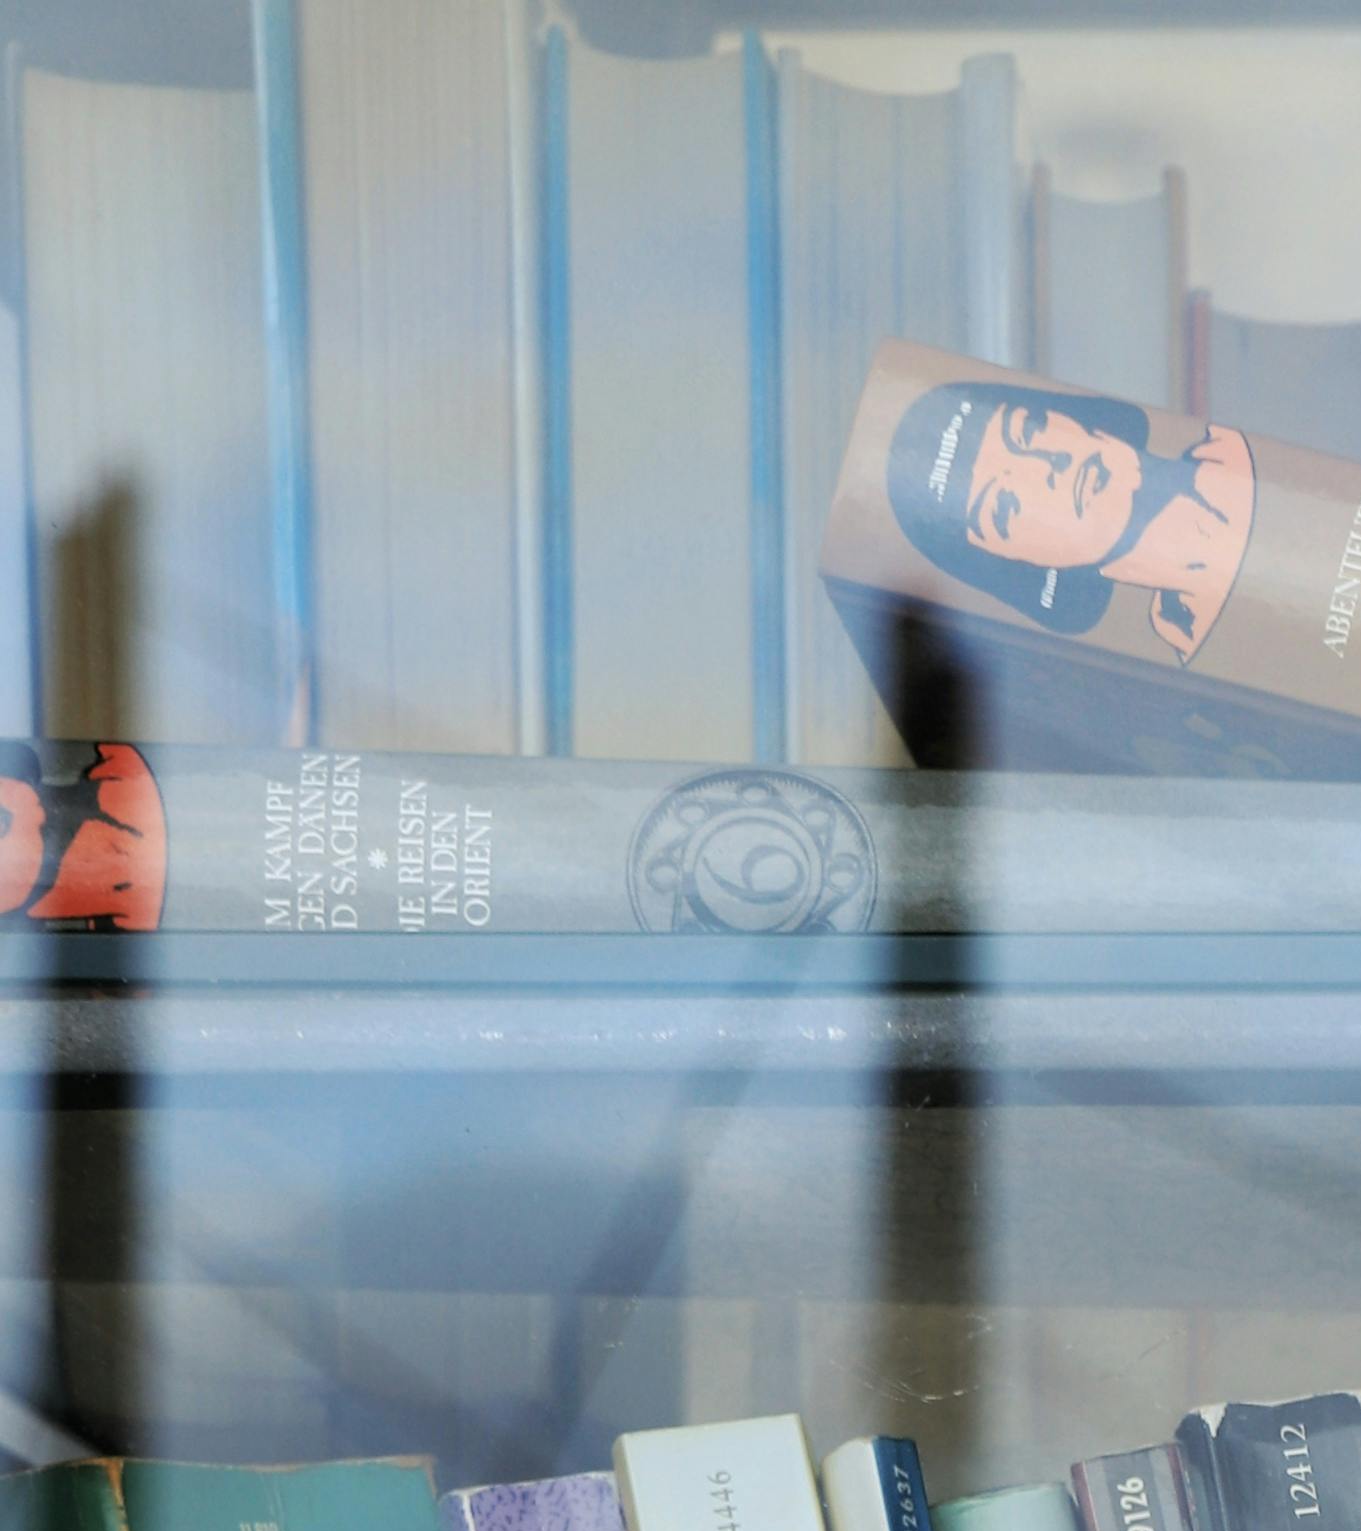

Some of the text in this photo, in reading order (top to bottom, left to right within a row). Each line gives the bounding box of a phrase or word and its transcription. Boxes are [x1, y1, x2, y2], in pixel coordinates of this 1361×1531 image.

[266, 780, 295, 892] KAMPF
[300, 752, 328, 855] DÄNEN
[332, 754, 360, 897] SACHSEN
[464, 806, 493, 927] ORIENT
[1281, 1424, 1320, 1519] 12412
